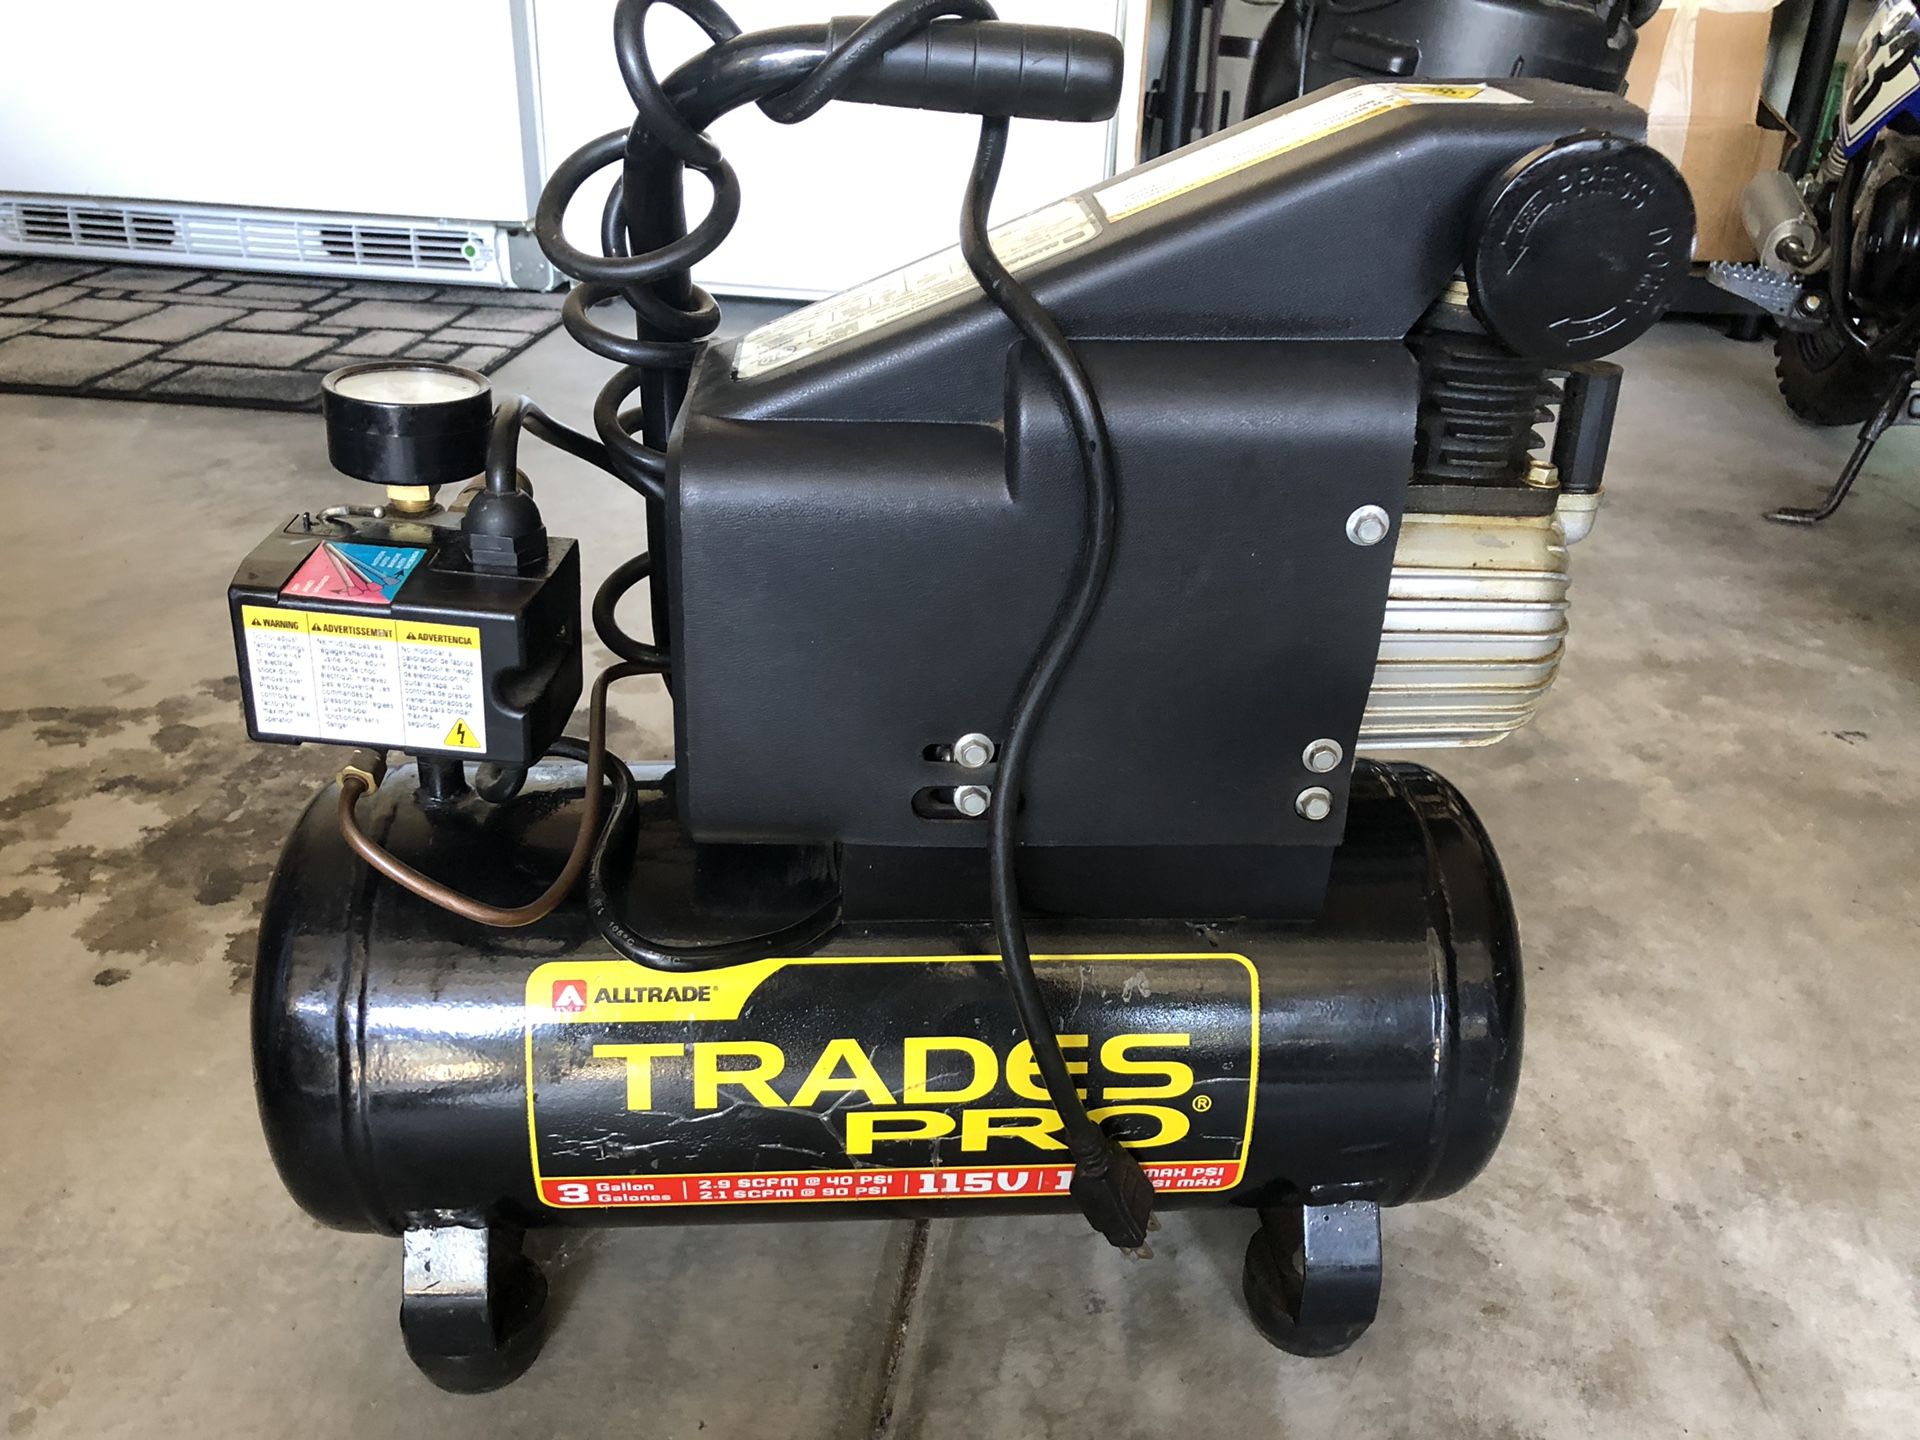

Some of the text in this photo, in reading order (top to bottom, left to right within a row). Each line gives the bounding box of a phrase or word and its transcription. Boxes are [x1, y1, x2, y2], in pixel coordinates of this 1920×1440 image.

[1555, 166, 1655, 210] PRESS
[262, 618, 299, 630] WARNING
[323, 624, 393, 638] ADVERTISSEMENT
[417, 633, 472, 645] ADVERTENCIA
[593, 1033, 1194, 1111] TRADES
[1192, 1167, 1225, 1177] PSI
[596, 1182, 655, 1192] Gallon
[698, 1175, 893, 1189] 2.9 SCFM @ 40 PSI
[918, 1171, 1029, 1194] 115V
[1152, 1179, 1171, 1188] SI
[557, 1183, 590, 1203] 3
[598, 1193, 671, 1202] Galones
[699, 1185, 888, 1200] 2.1 SCFM @ 90 PSI
